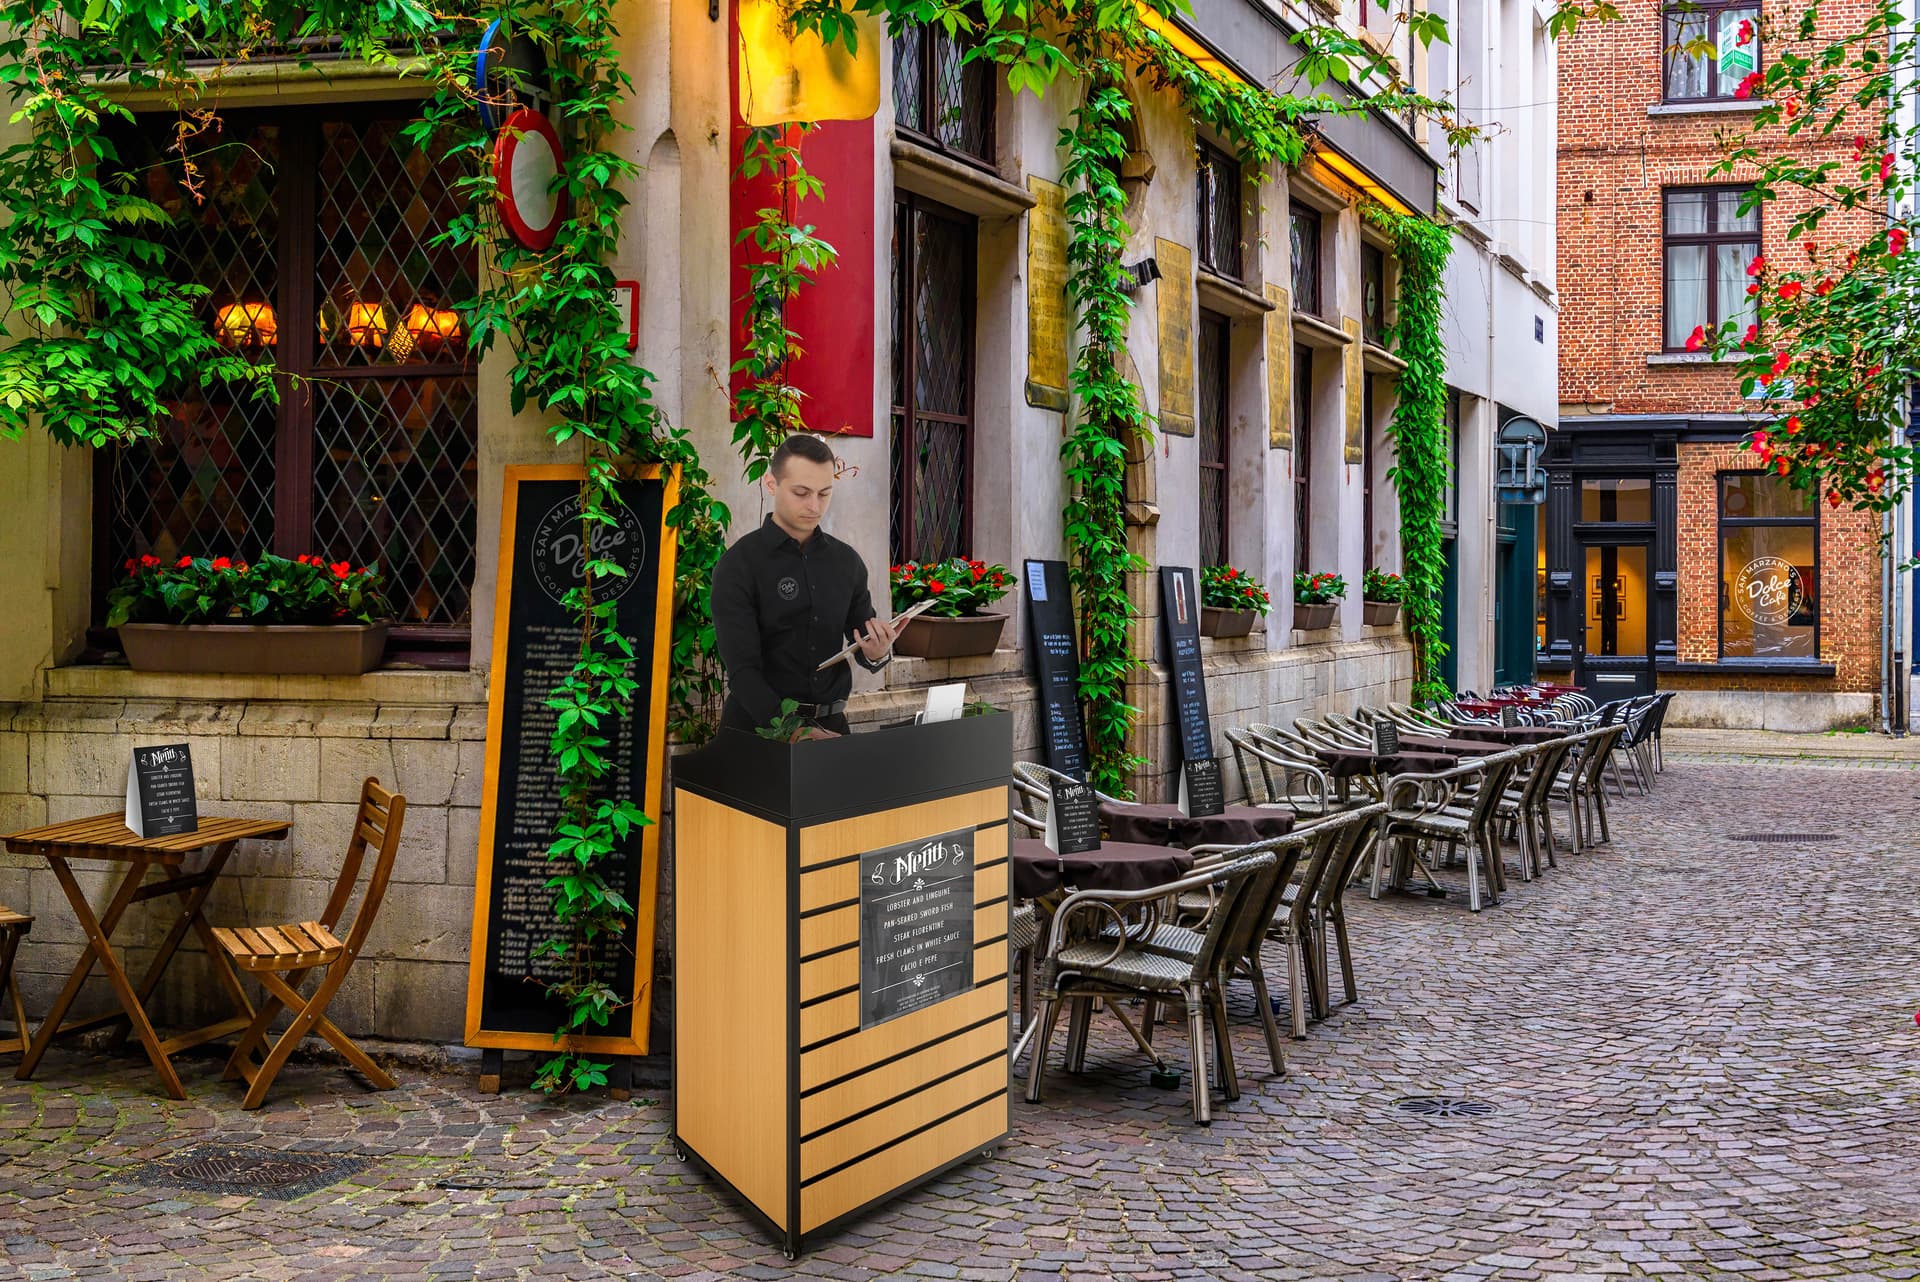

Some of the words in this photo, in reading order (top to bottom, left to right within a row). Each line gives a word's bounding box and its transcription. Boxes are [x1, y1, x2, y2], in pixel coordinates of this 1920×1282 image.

[536, 526, 553, 557] SAN
[601, 547, 641, 601] DESSERTS
[1738, 575, 1748, 594] SAN
[1745, 560, 1797, 578] MARZANO'S
[1746, 575, 1792, 599] Dolce
[1743, 604, 1768, 622] COFFEE
[886, 898, 911, 912] LOBSTER
[912, 894, 924, 905] AND
[926, 887, 951, 901] LINGUINE
[883, 912, 918, 929] PAN-SEARED
[919, 906, 940, 919] SWORD
[941, 902, 954, 912] FISH
[893, 932, 910, 943] STEAK
[912, 920, 945, 937] FLORENTINE
[876, 953, 895, 965] FRESH
[896, 945, 915, 958] CLAMS
[916, 943, 923, 951] IN
[924, 936, 941, 949] WHITE
[943, 931, 960, 943] SAUCE
[900, 961, 917, 973] CACIO
[919, 959, 923, 967] E
[924, 954, 938, 965] PEPE
